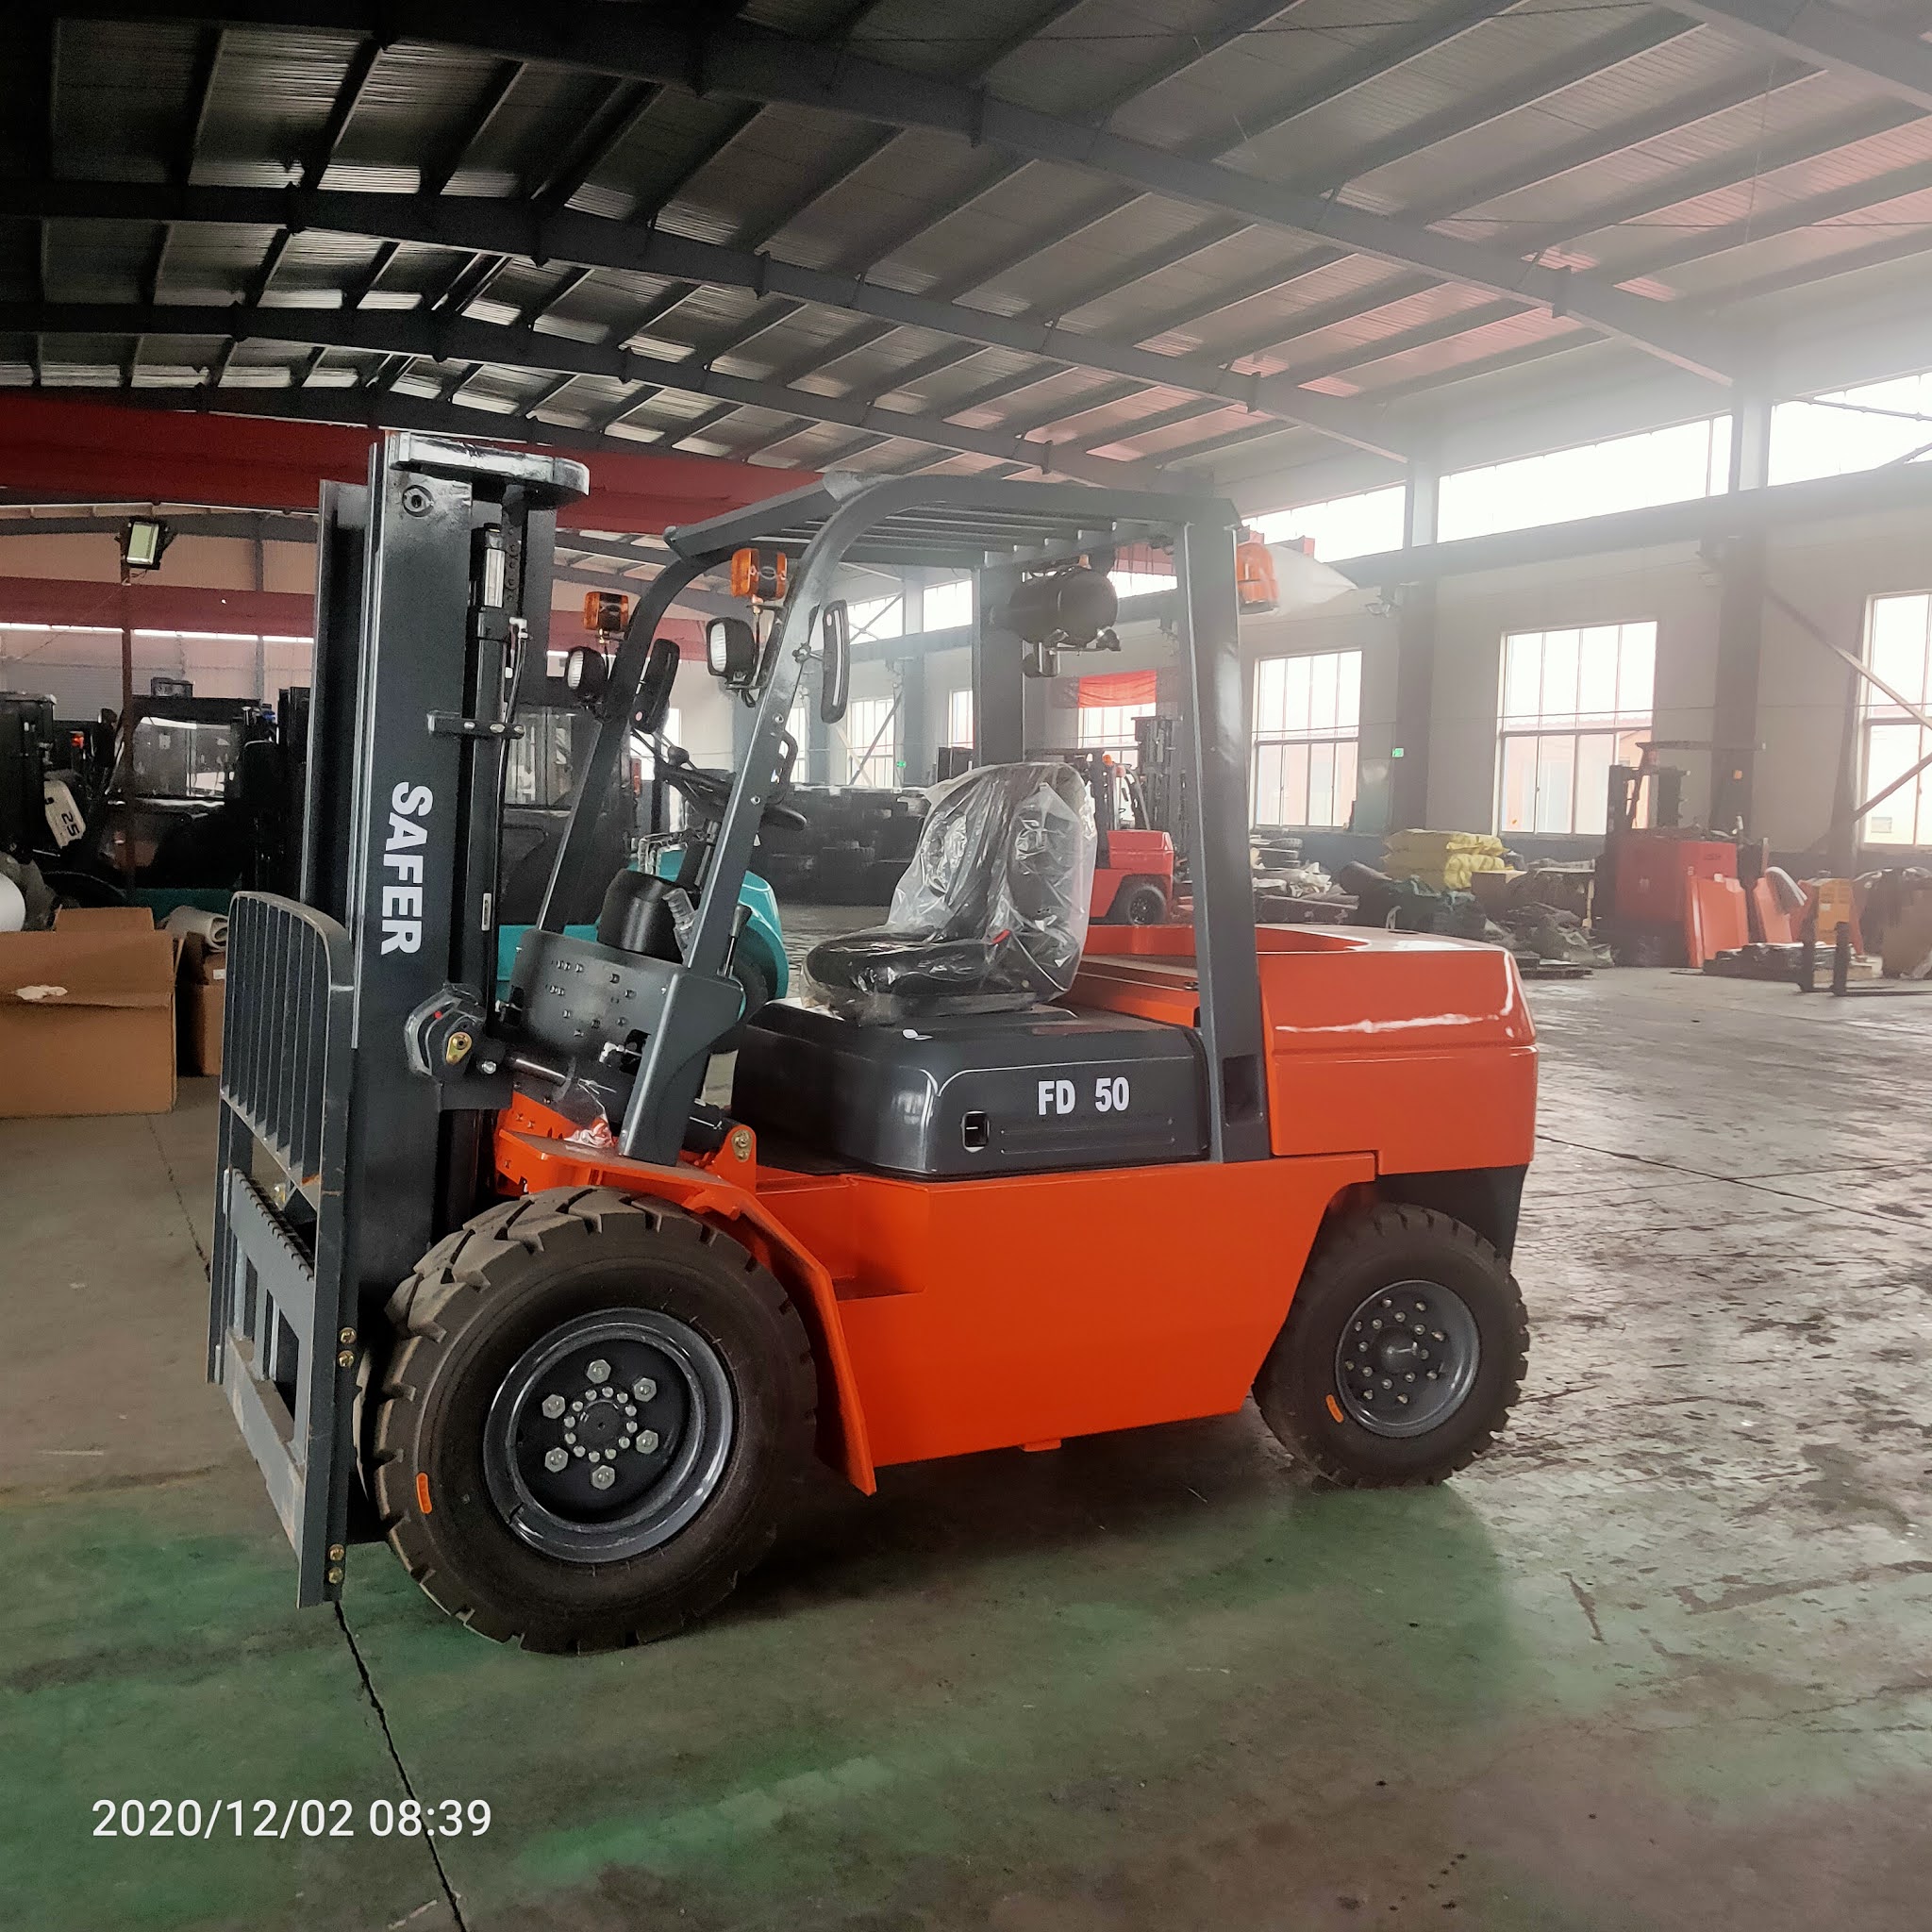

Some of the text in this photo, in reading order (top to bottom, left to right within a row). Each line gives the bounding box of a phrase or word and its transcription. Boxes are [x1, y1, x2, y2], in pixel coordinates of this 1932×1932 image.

[61, 811, 80, 836] 25
[381, 782, 434, 956] SAFER
[1038, 1076, 1130, 1116] FD 50
